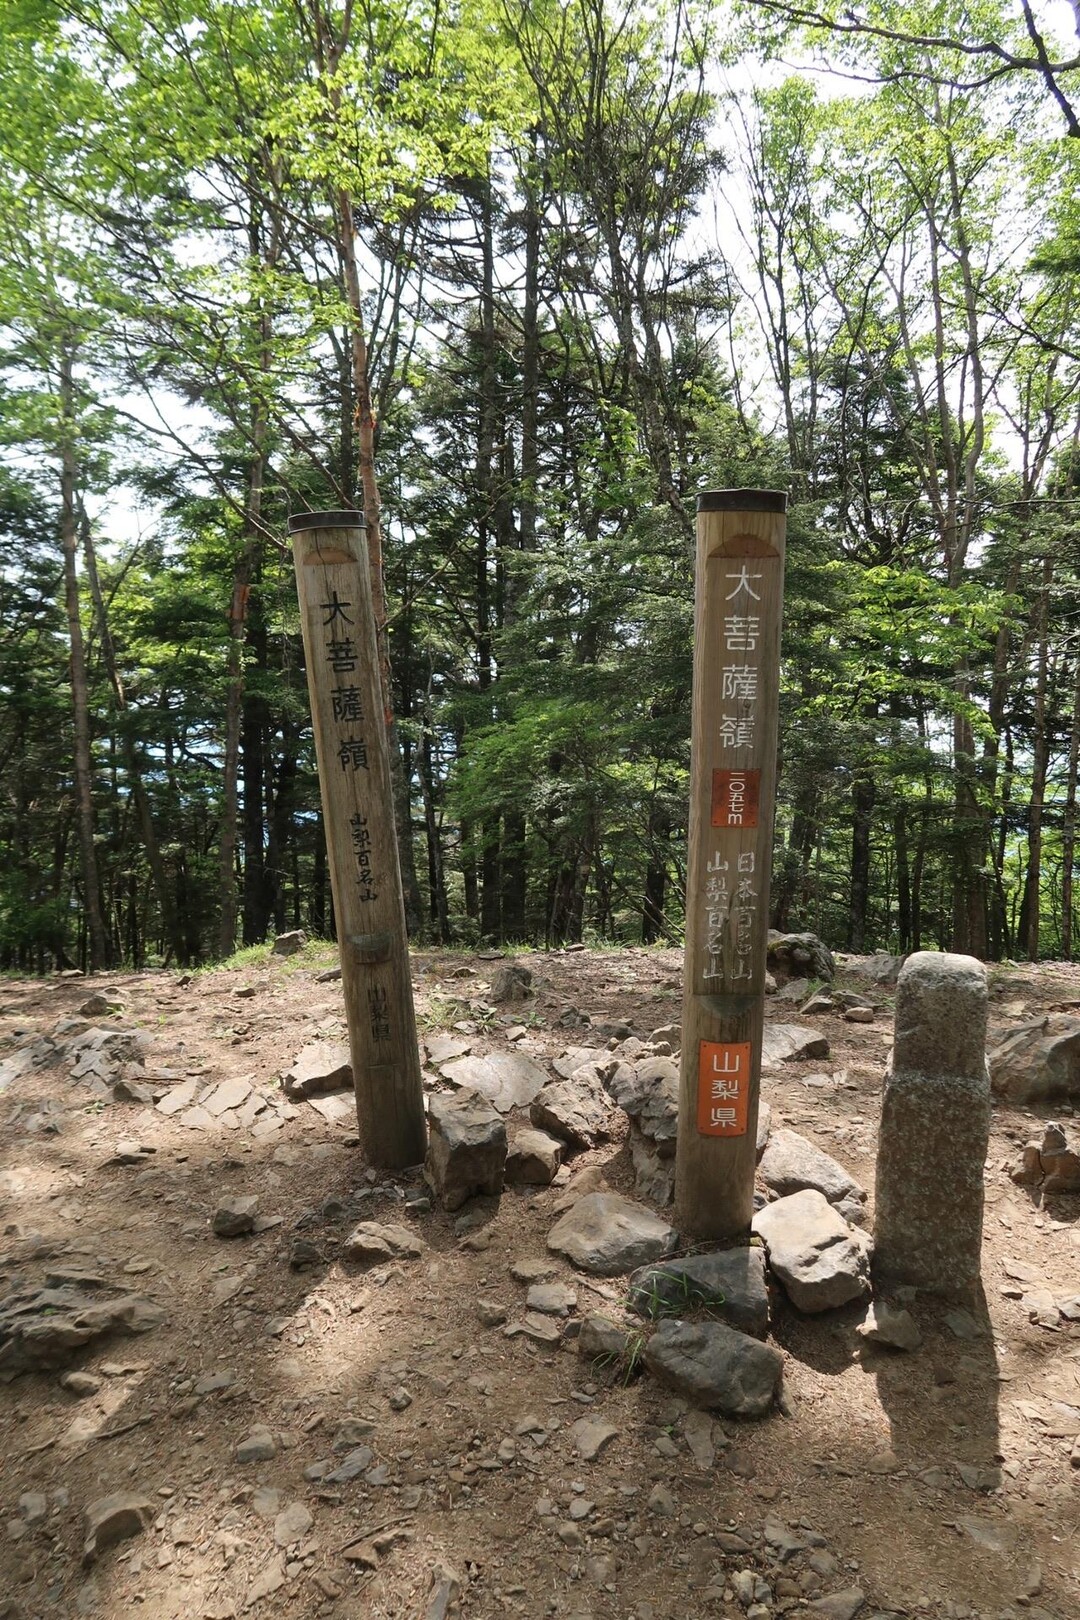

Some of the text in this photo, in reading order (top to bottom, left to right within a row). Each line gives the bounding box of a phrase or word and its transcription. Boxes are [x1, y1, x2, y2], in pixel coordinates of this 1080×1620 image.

[320, 591, 371, 772] 大菩薩嶺
[719, 564, 763, 749] 大菩薩嶺
[350, 812, 378, 903] 山梨百名山
[710, 1051, 740, 1128] 山梨県
